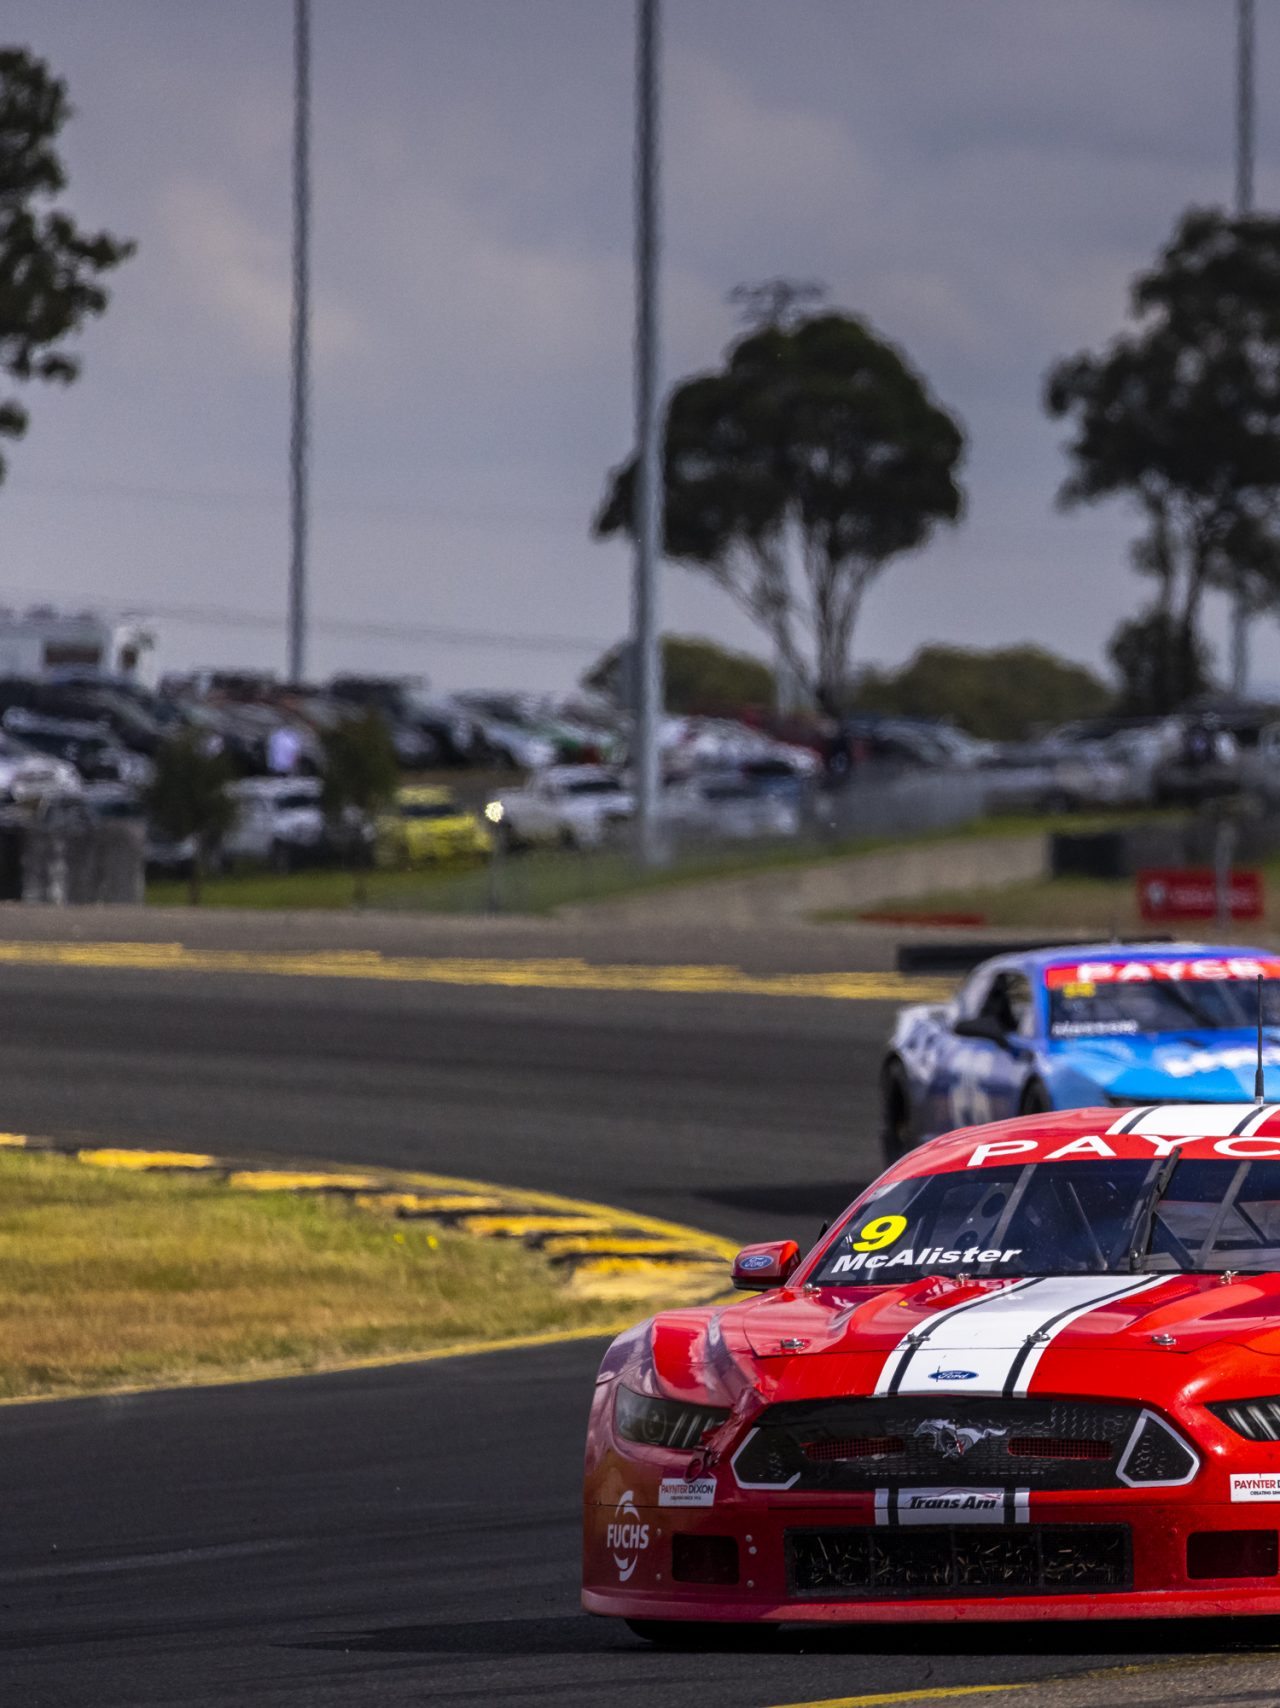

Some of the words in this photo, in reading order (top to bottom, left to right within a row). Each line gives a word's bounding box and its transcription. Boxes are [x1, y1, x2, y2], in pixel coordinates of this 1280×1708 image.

[853, 1215, 907, 1252] 9
[831, 1247, 1022, 1273] McAlister
[661, 1485, 688, 1494] PAYNTER
[688, 1485, 714, 1494] DIXON
[1234, 1480, 1276, 1490] PAYNTER
[910, 1496, 960, 1509] Trans
[961, 1496, 997, 1509] Am
[606, 1523, 650, 1549] FUCHS
